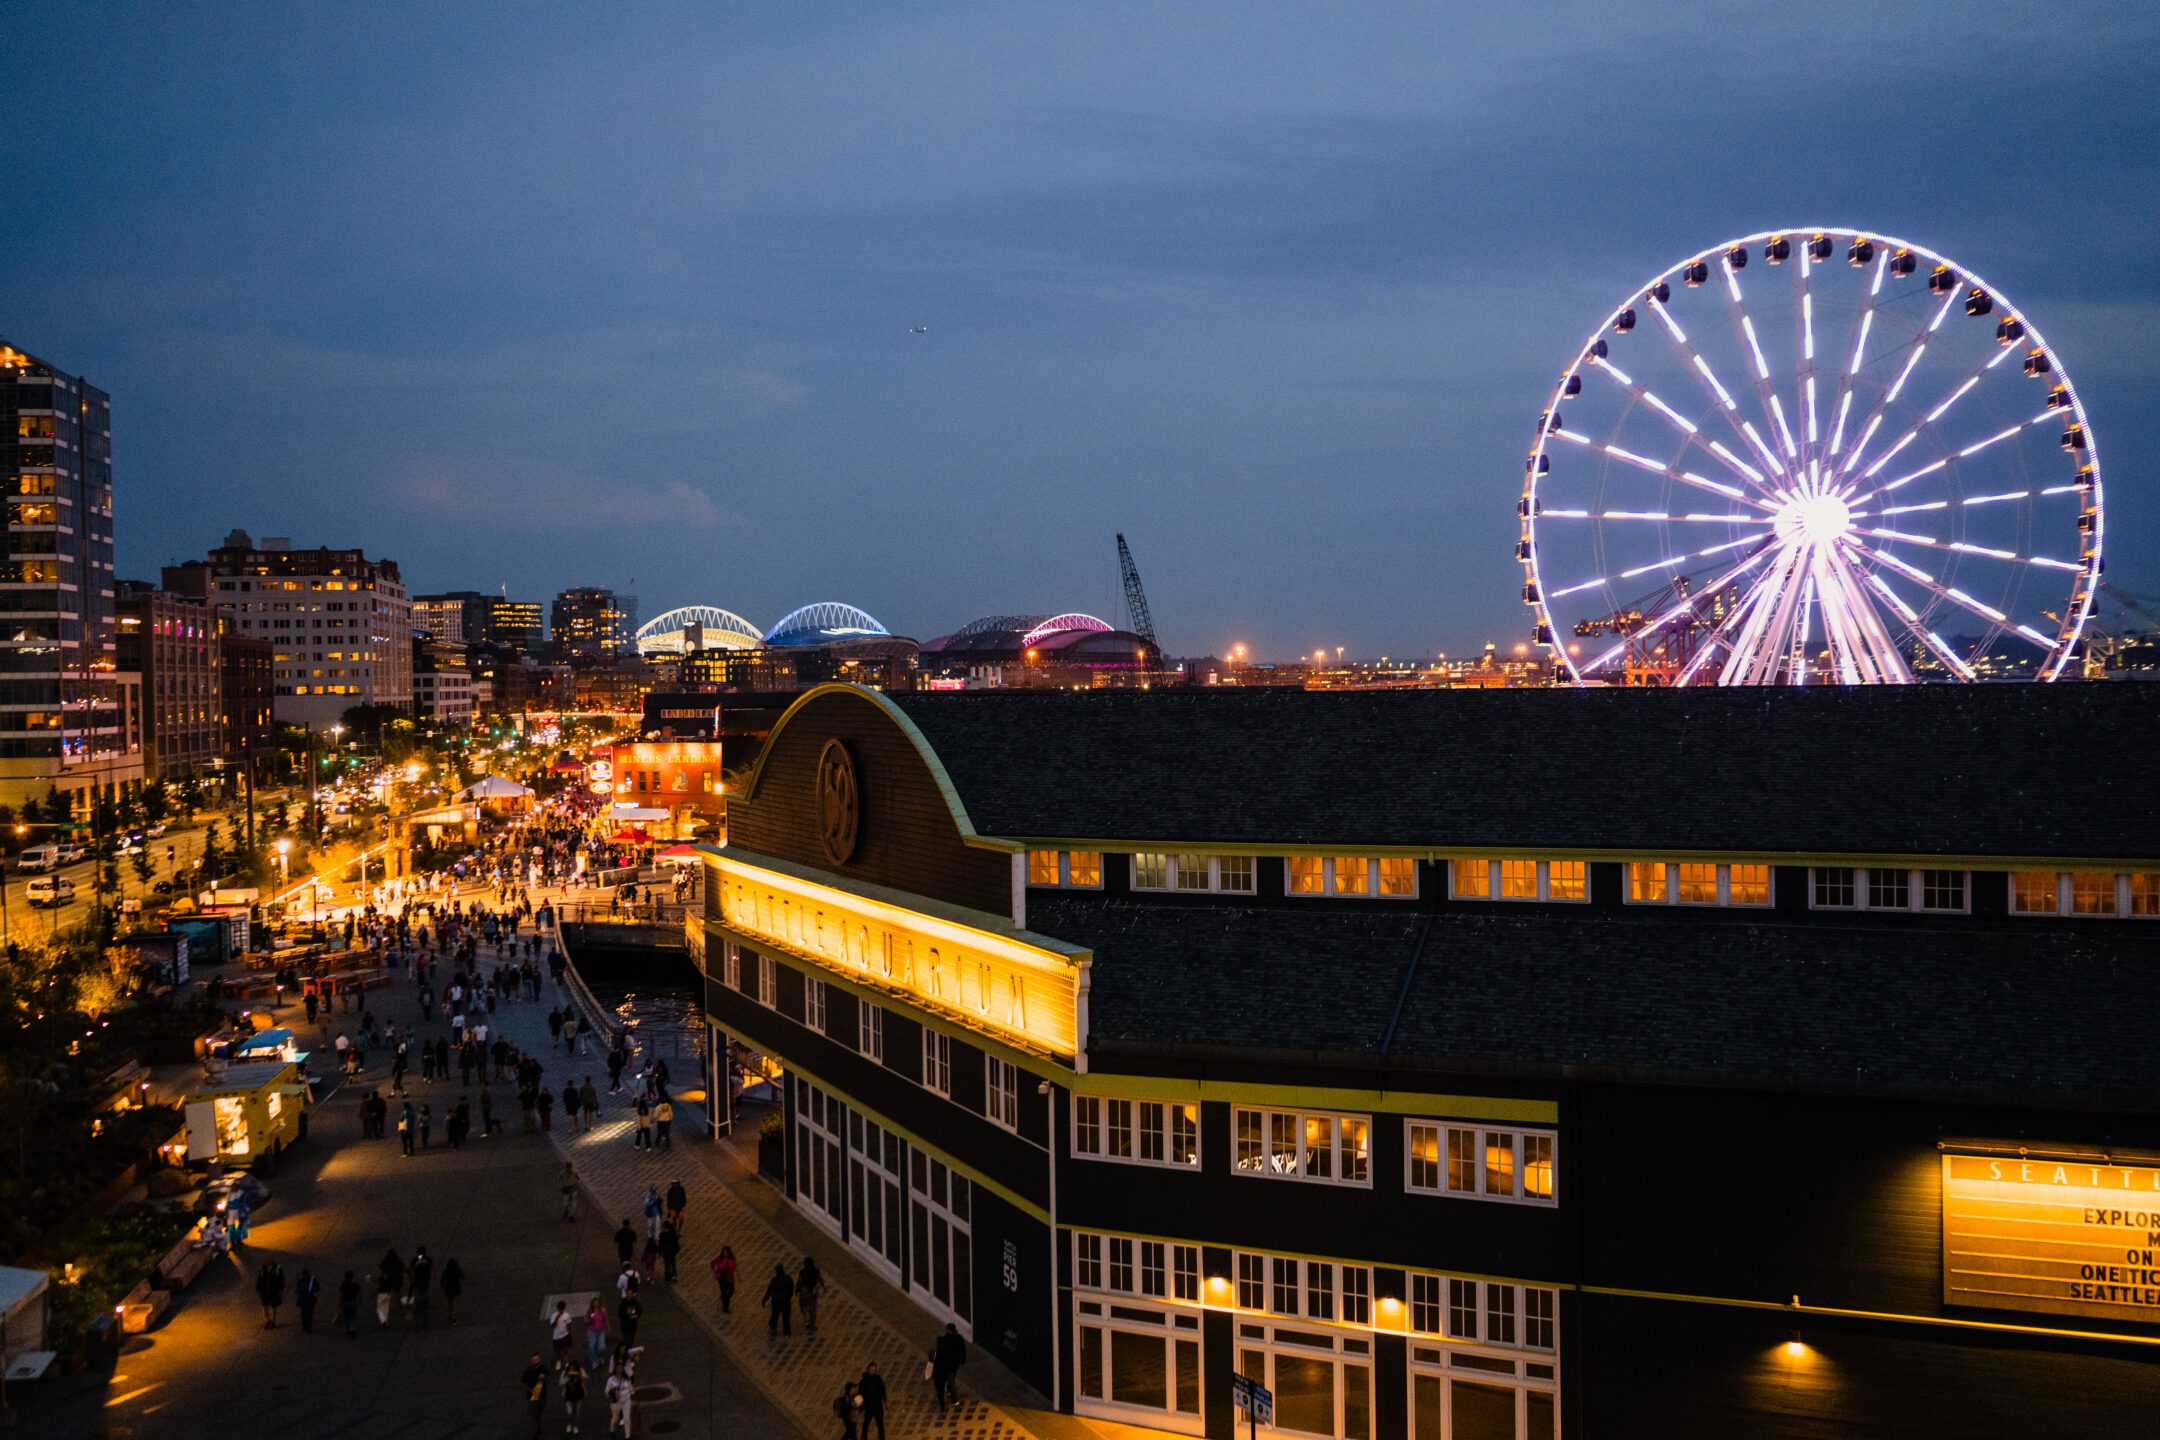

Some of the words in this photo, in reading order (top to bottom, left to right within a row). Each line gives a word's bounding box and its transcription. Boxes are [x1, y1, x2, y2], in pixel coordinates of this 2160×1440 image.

[668, 755, 717, 764] LANDING
[722, 880, 825, 952] SEATTLE
[838, 919, 1025, 1029] AQUARIUM
[2126, 1249, 2153, 1266] ON
[1003, 1263, 1018, 1292] 59
[2081, 1265, 2120, 1282] ONE
[2070, 1283, 2160, 1305] SEATTLE
